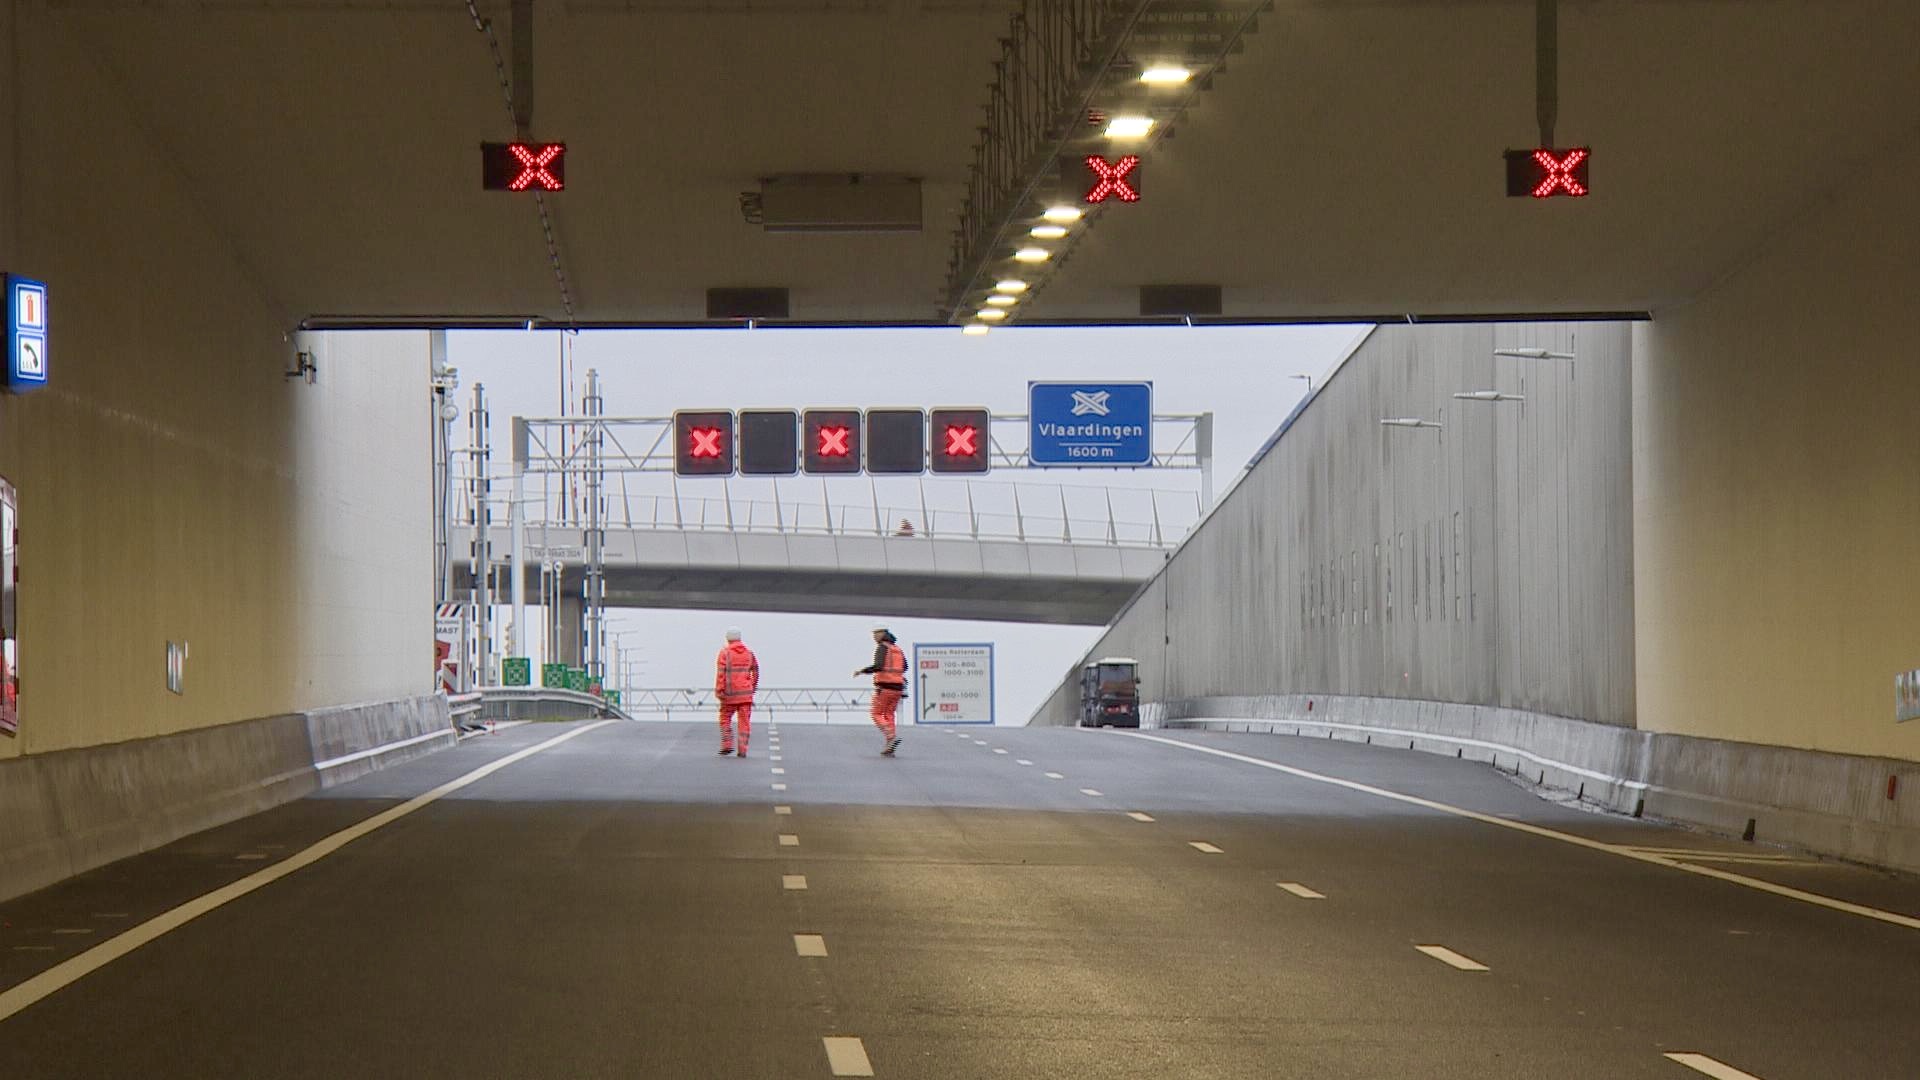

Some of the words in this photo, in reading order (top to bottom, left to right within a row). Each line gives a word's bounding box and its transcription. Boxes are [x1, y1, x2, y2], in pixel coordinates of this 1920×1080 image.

[1038, 423, 1143, 440] Vlaardingen
[1067, 447, 1098, 457] 1600
[1101, 448, 1114, 457] m
